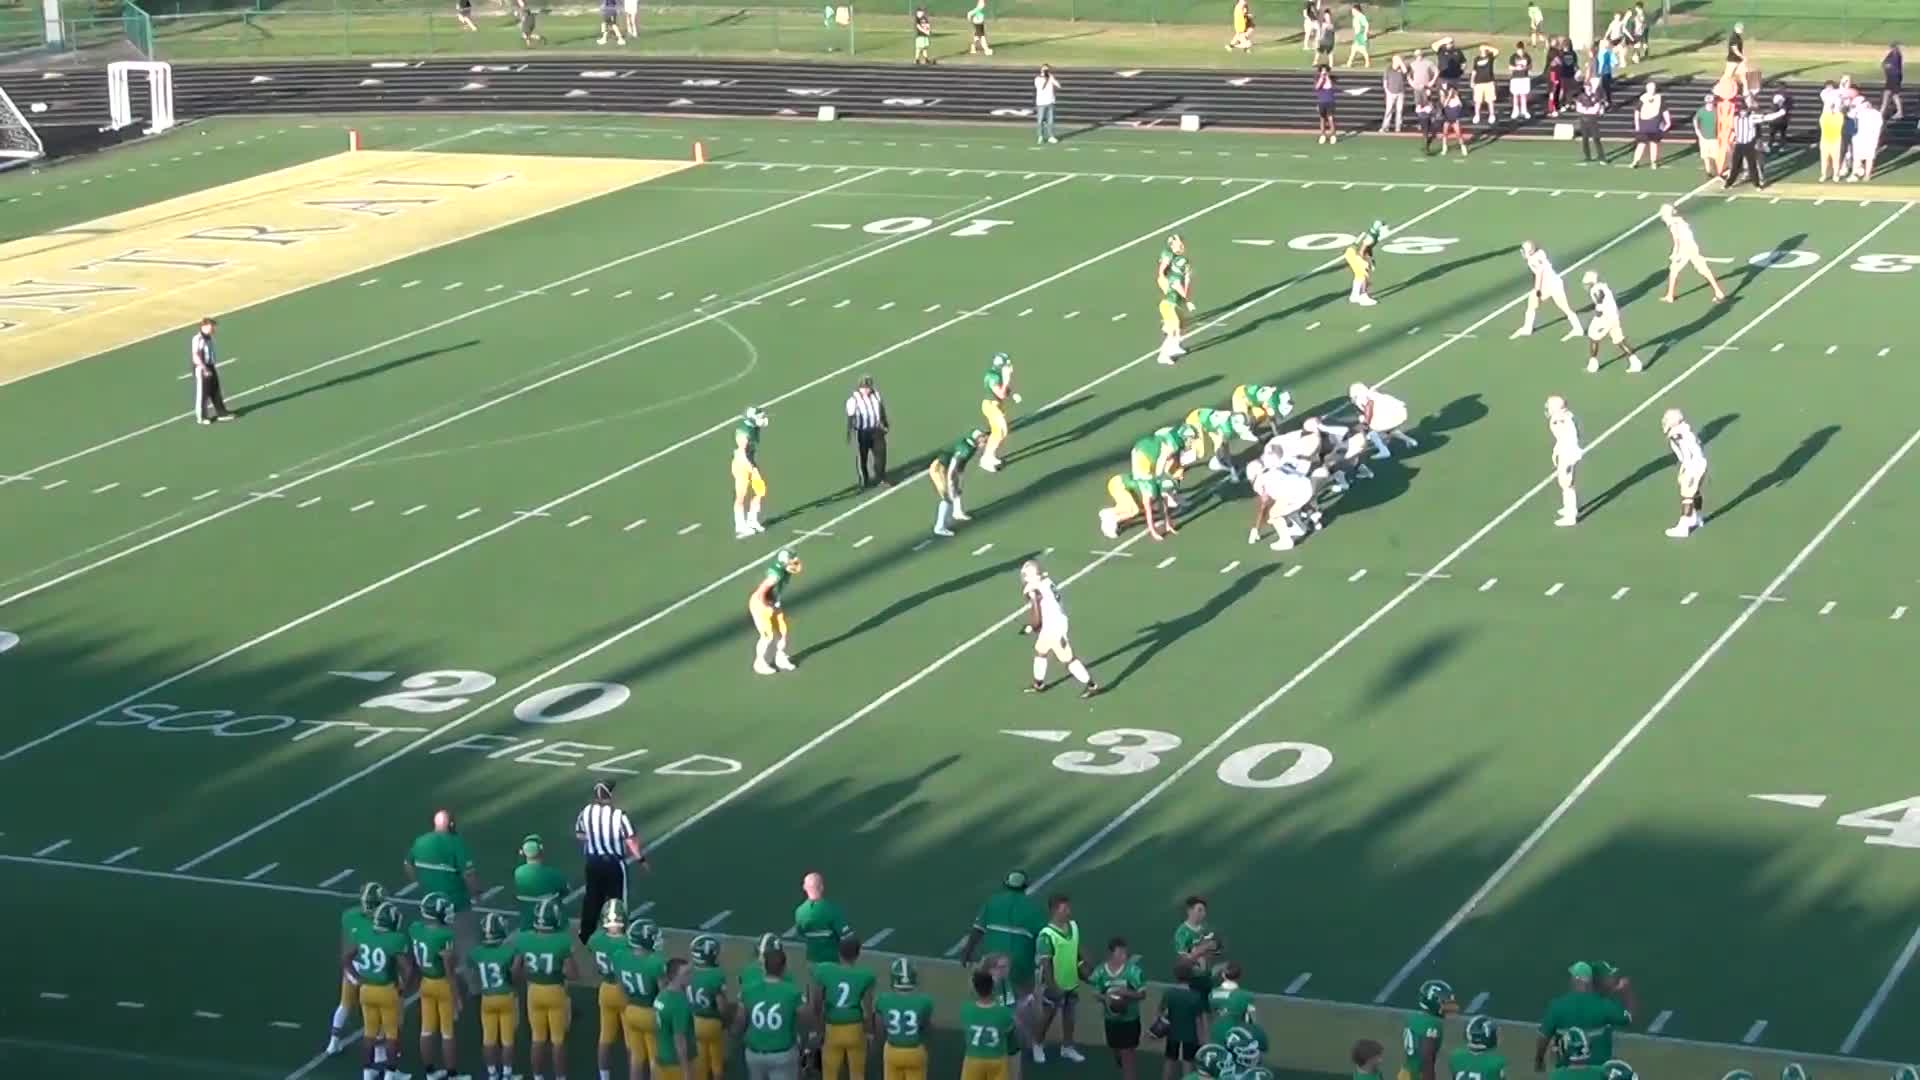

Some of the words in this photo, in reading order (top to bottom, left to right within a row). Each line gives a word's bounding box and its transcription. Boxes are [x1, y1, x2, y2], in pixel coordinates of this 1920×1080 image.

[0, 174, 516, 330] NTRAL
[97, 704, 430, 748] SCOTT
[429, 734, 744, 776] FIELD
[358, 943, 386, 972] 39
[478, 962, 503, 988] 13
[621, 970, 646, 995] 51
[836, 982, 850, 1007] 2
[751, 1001, 782, 1030] 66
[887, 1009, 918, 1035] 33
[970, 1024, 999, 1047] 73
